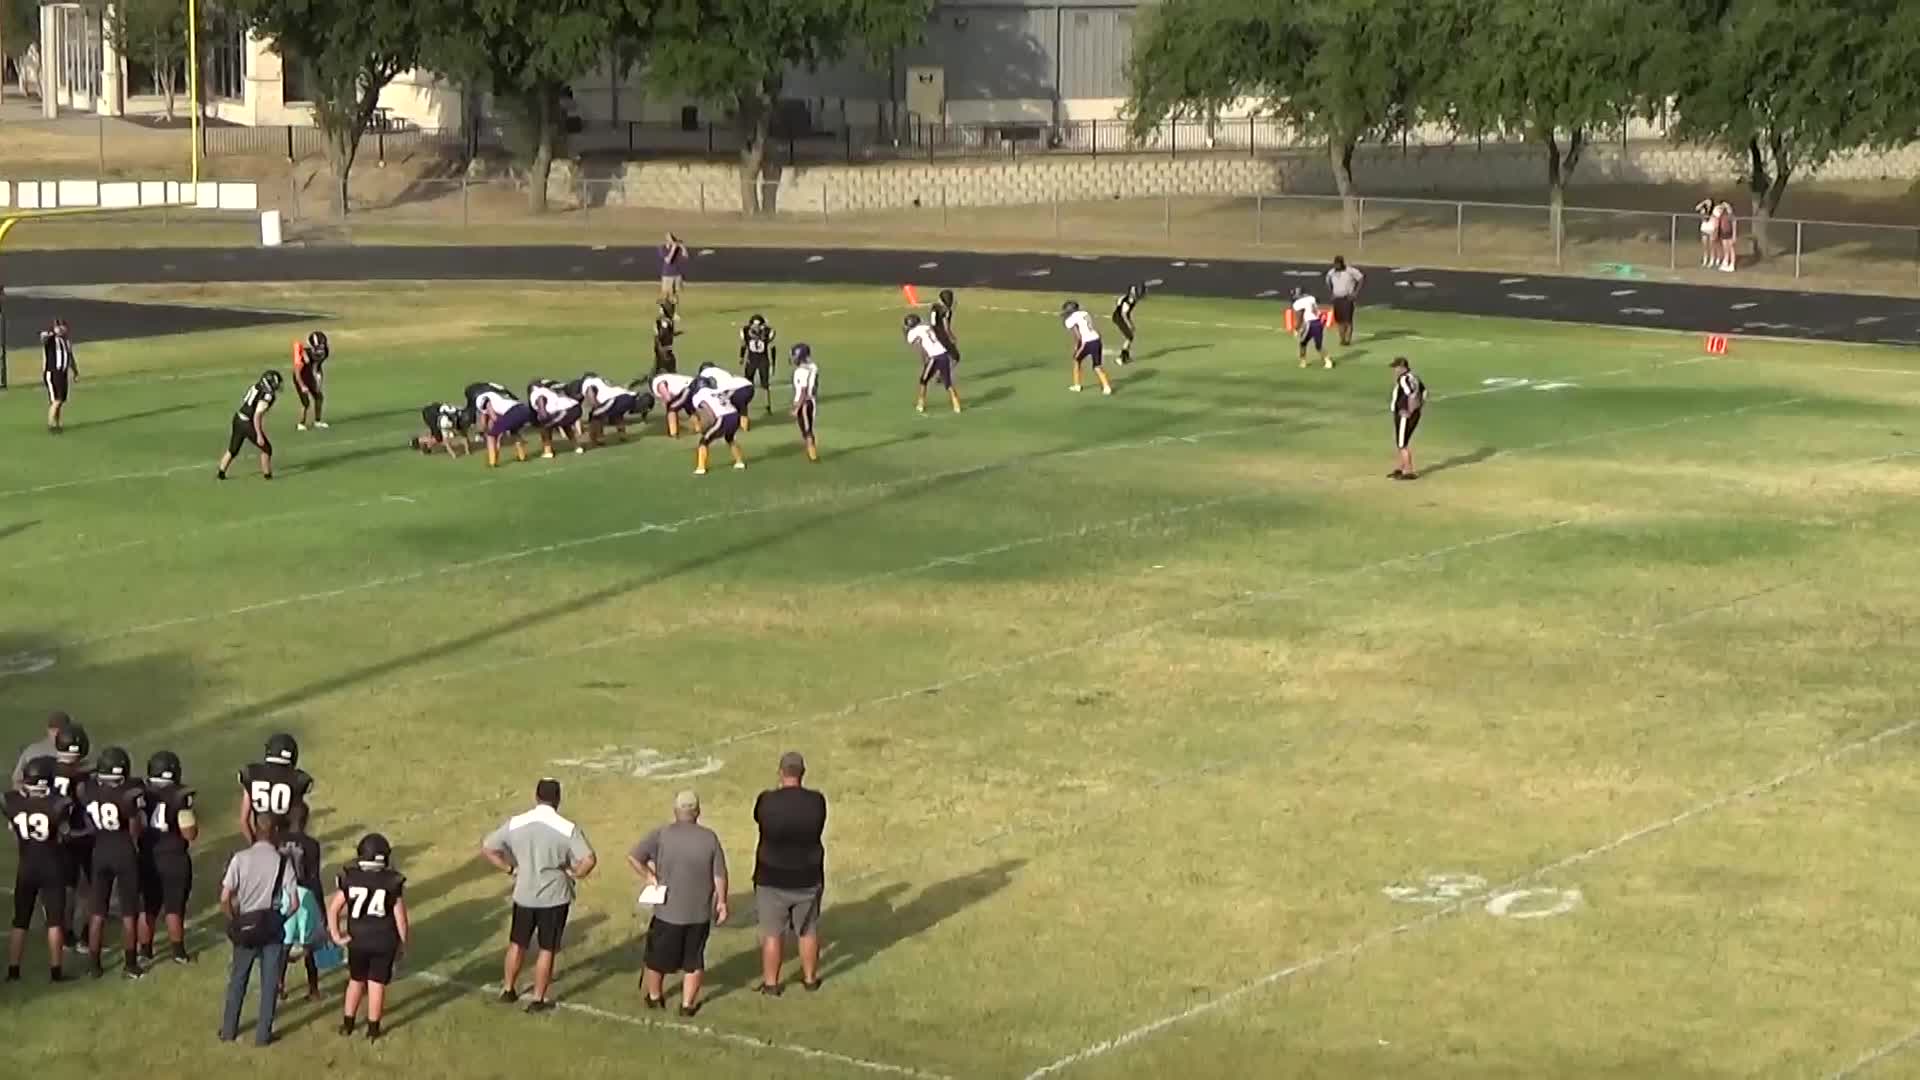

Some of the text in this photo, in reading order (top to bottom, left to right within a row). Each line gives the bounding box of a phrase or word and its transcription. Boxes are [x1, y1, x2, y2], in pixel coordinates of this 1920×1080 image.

[251, 780, 291, 814] 50
[13, 811, 49, 842] 13
[86, 800, 120, 830] 18
[348, 886, 387, 919] 74
